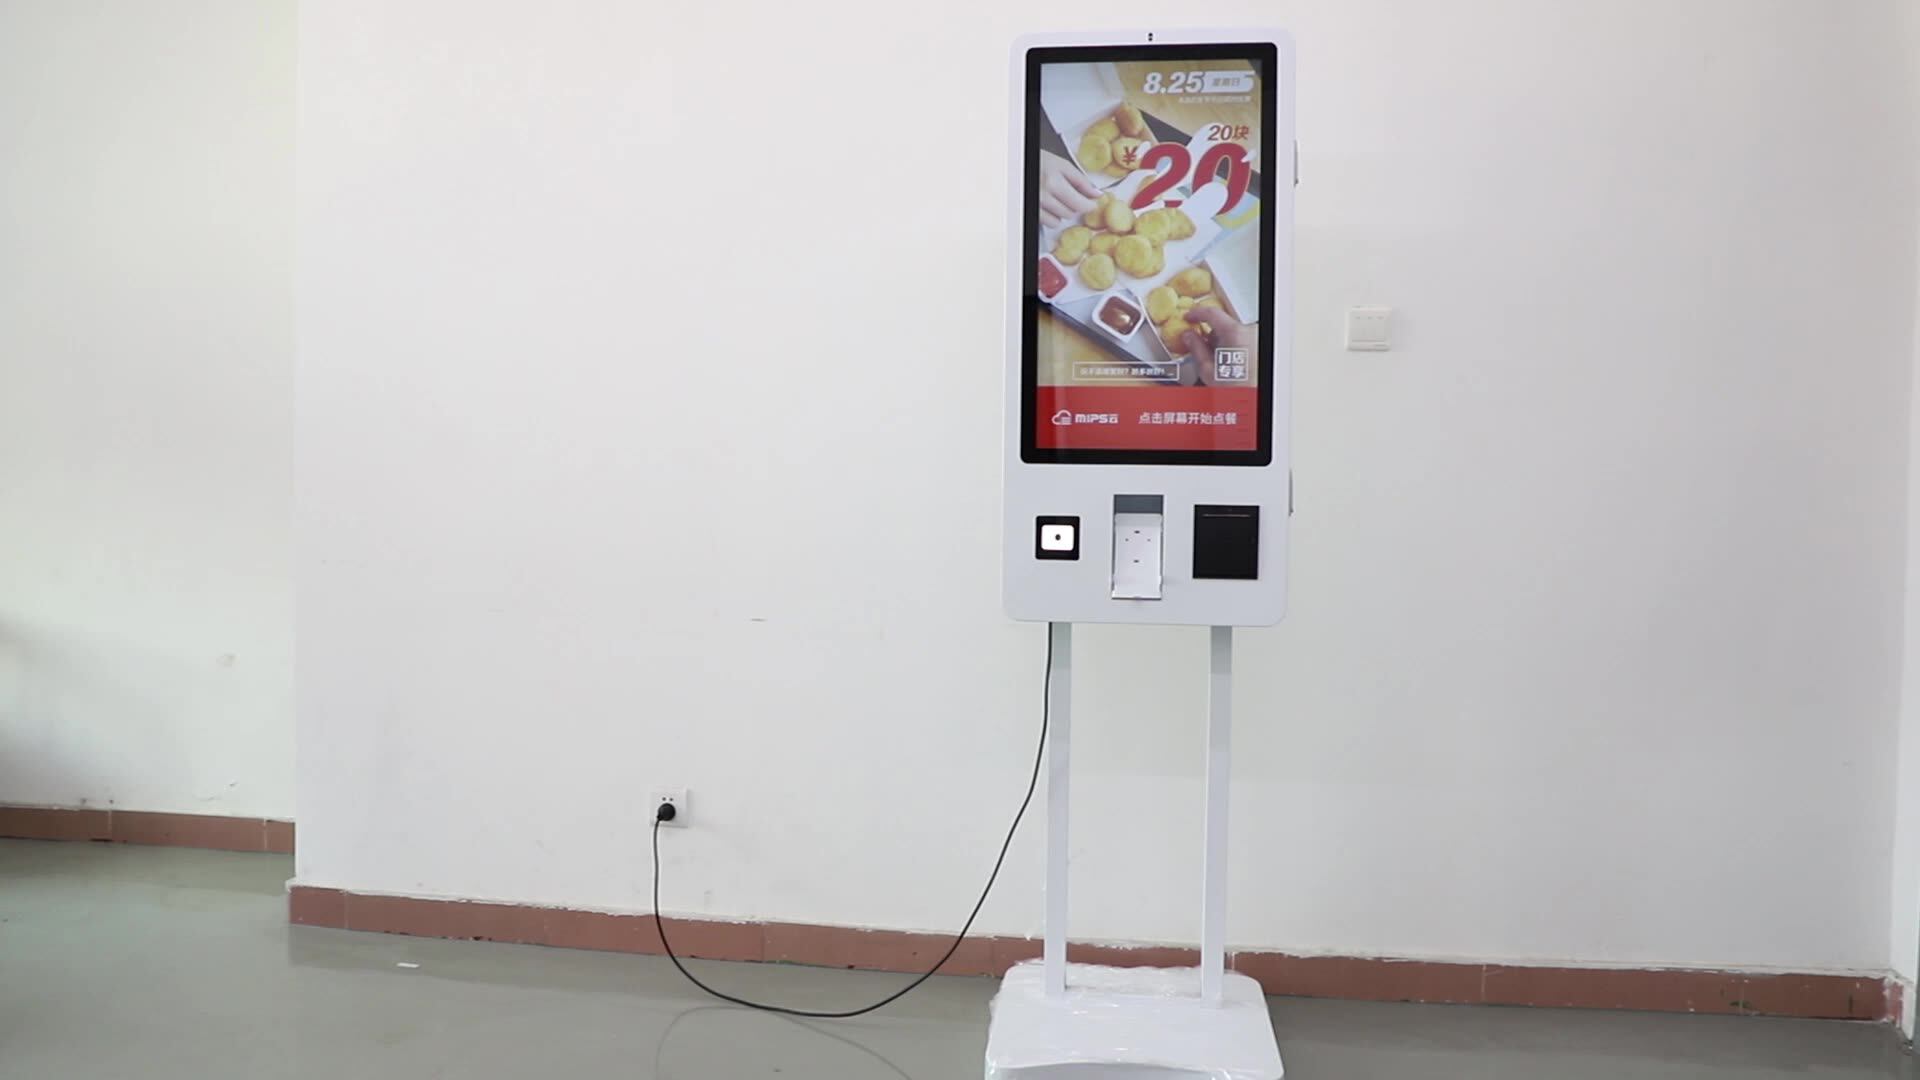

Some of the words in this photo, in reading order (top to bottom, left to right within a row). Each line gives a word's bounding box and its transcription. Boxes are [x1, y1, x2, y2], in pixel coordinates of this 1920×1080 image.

[1143, 71, 1204, 94] 8.25
[1207, 124, 1249, 141] 20块
[1218, 351, 1246, 365] 门店
[1218, 365, 1246, 379] 专享
[1138, 411, 1238, 425] 点击屏幕开始点餐
